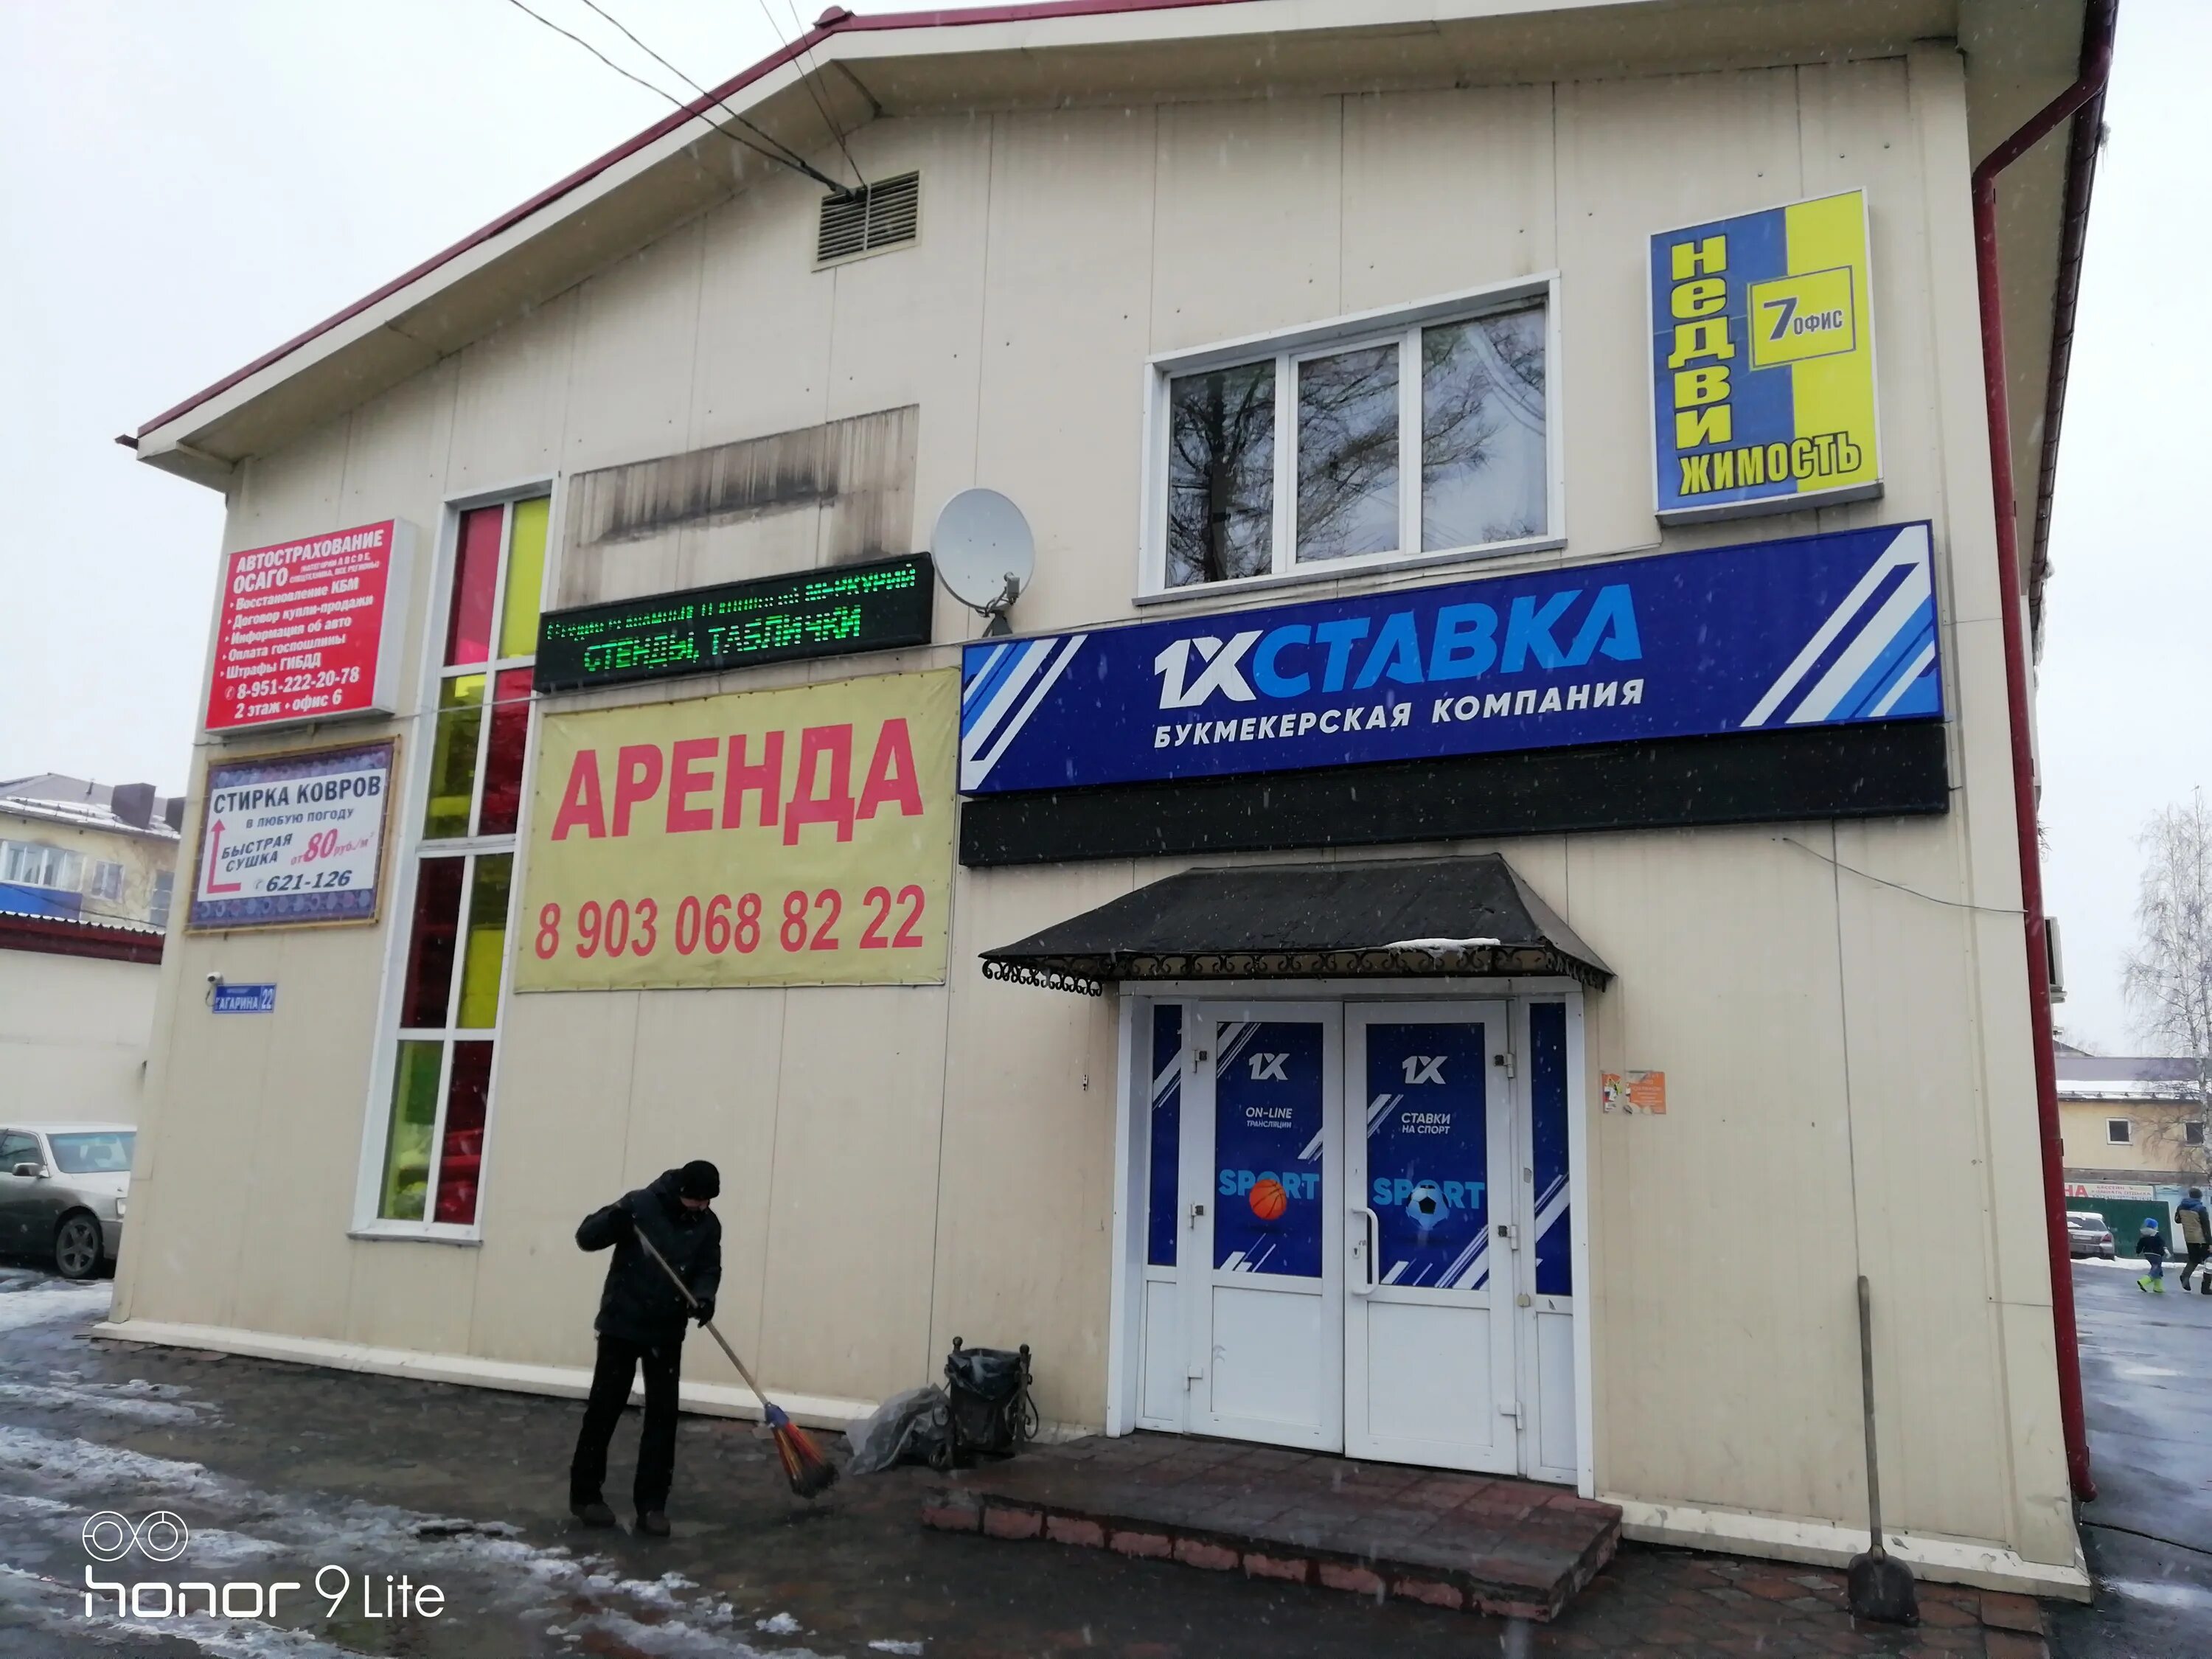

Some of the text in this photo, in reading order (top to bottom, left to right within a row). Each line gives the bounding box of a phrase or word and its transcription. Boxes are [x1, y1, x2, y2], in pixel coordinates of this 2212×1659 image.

[1763, 297, 1798, 341] 7
[1677, 430, 1862, 496] ЖИМОСТЬ
[236, 529, 384, 573] АВТОСТРАХОВАНИЕ
[233, 567, 288, 594] ОСАГО
[236, 577, 360, 611] Восстановление КБМ
[232, 595, 374, 629] Договор купли-продажи
[231, 616, 352, 645] Информация об авто
[707, 604, 861, 655] ТАБЛИЧКИ
[228, 633, 347, 662] Оплата госпошлины
[226, 653, 321, 679] Штрафы ГИБДД
[236, 666, 361, 700] 8-951-222-20-78
[234, 689, 342, 719] 2 этаж офис 6
[1154, 678, 1644, 748] БУКМЕКЕРСКАЯ КОМПАНИЯ
[213, 776, 380, 814] СТИРКА КОВРОВ
[551, 717, 924, 846] АРЕНДА
[246, 808, 355, 829] В ЛЮБУЮ ПОГОДУ
[221, 833, 293, 860] БЫСТРАЯ
[226, 851, 278, 873] СУШКА
[266, 869, 352, 892] 621-126
[535, 885, 925, 960] 8 903 068 82 22
[215, 988, 274, 1009] ГАГАРИНА 22
[1245, 1107, 1293, 1119] ON-LINE
[1246, 1120, 1292, 1130] ТРАНСЛЯЦИИ
[1401, 1113, 1451, 1124] СТАВКИ
[1402, 1124, 1450, 1135] НА СПОРТ
